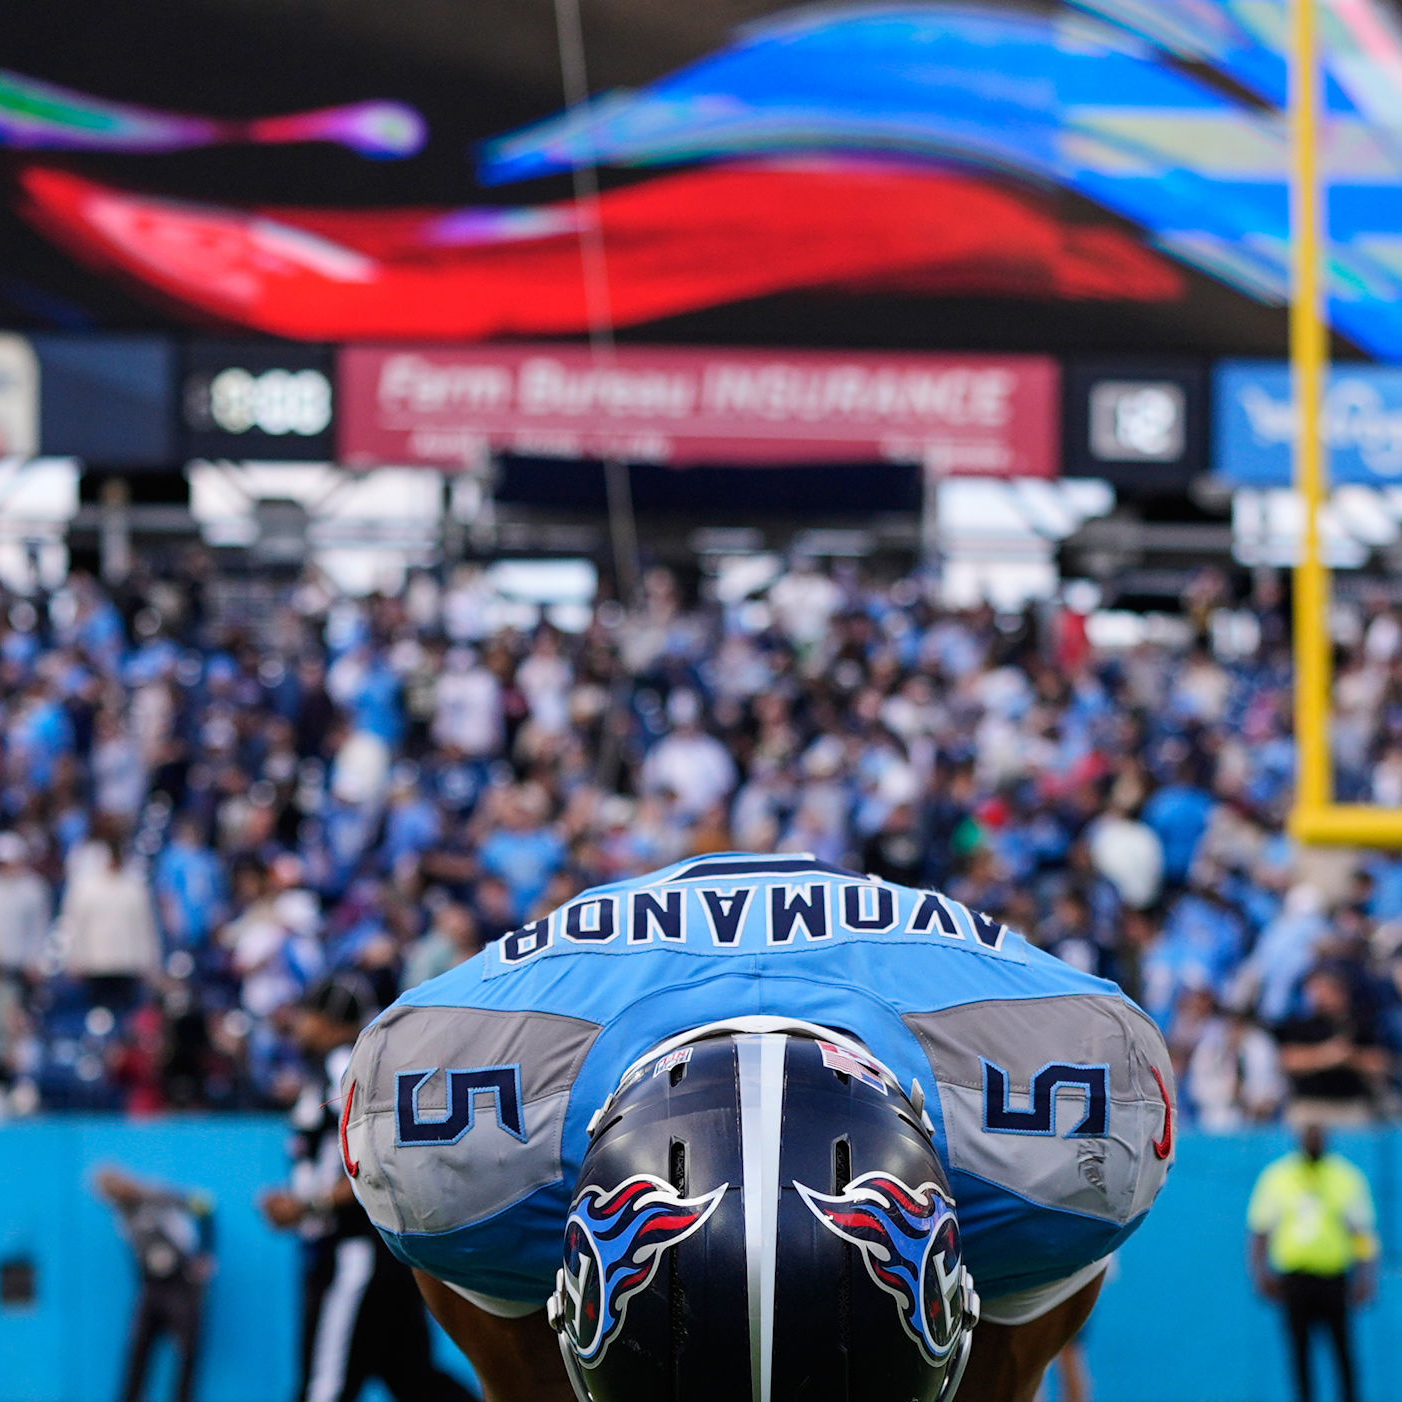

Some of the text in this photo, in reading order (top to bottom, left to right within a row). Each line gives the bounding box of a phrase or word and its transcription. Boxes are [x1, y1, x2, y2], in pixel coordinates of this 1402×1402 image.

[499, 882, 1008, 965] AYOMANOR
[395, 1063, 529, 1147] 5
[978, 1055, 1110, 1138] 5
